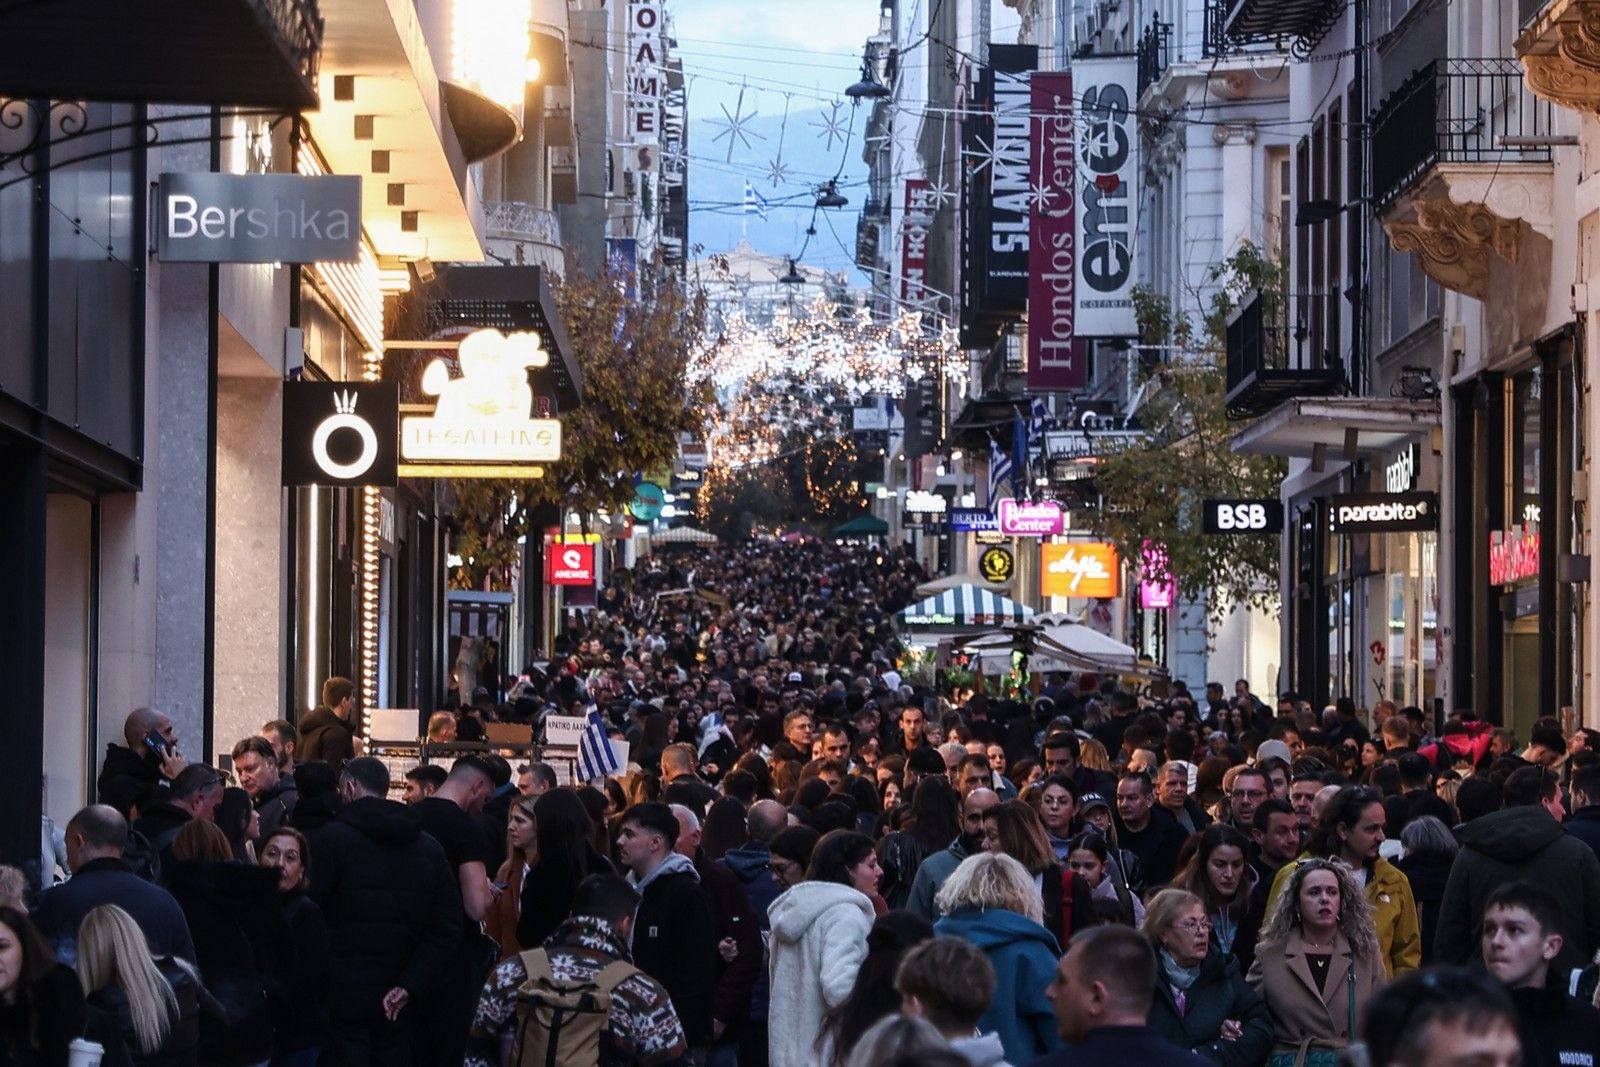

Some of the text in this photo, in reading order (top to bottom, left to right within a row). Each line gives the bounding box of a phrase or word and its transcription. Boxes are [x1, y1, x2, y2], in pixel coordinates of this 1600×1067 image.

[992, 70, 1031, 252] SLAMDUNK
[168, 195, 349, 240] Bershka
[1040, 95, 1074, 370] Hondos Center
[1006, 519, 1055, 534] Center
[1217, 504, 1267, 530] BSB
[1339, 502, 1416, 525] parabita
